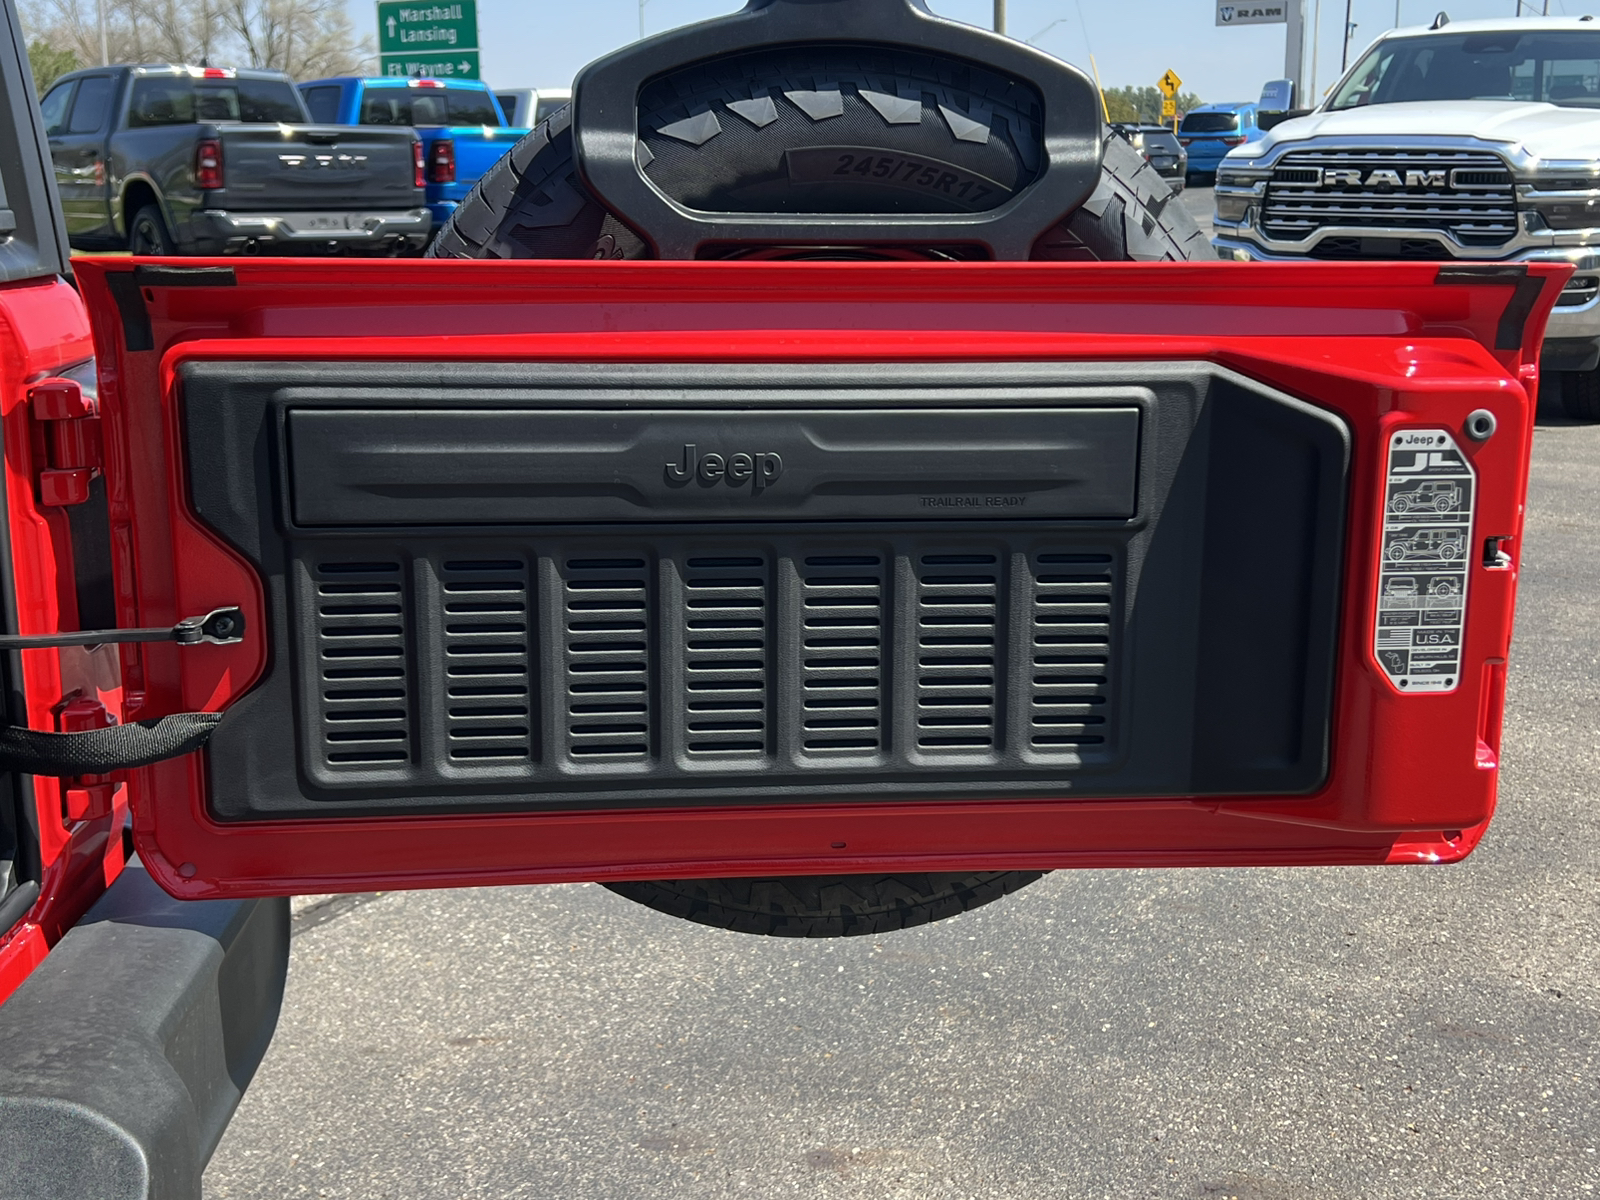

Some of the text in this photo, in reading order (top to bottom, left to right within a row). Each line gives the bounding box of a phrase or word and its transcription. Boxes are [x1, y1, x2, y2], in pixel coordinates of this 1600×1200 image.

[399, 4, 462, 22] Marshall
[1237, 8, 1282, 18] RAM
[400, 26, 457, 44] Lansing
[388, 62, 454, 77] Ft Wayne
[278, 154, 368, 170] RAM
[833, 154, 993, 203] 245/75R17
[1324, 169, 1446, 187] RAM
[1405, 435, 1434, 446] Jeep
[664, 444, 783, 491] Jeep
[920, 496, 1026, 507] TRAILRAIL READY
